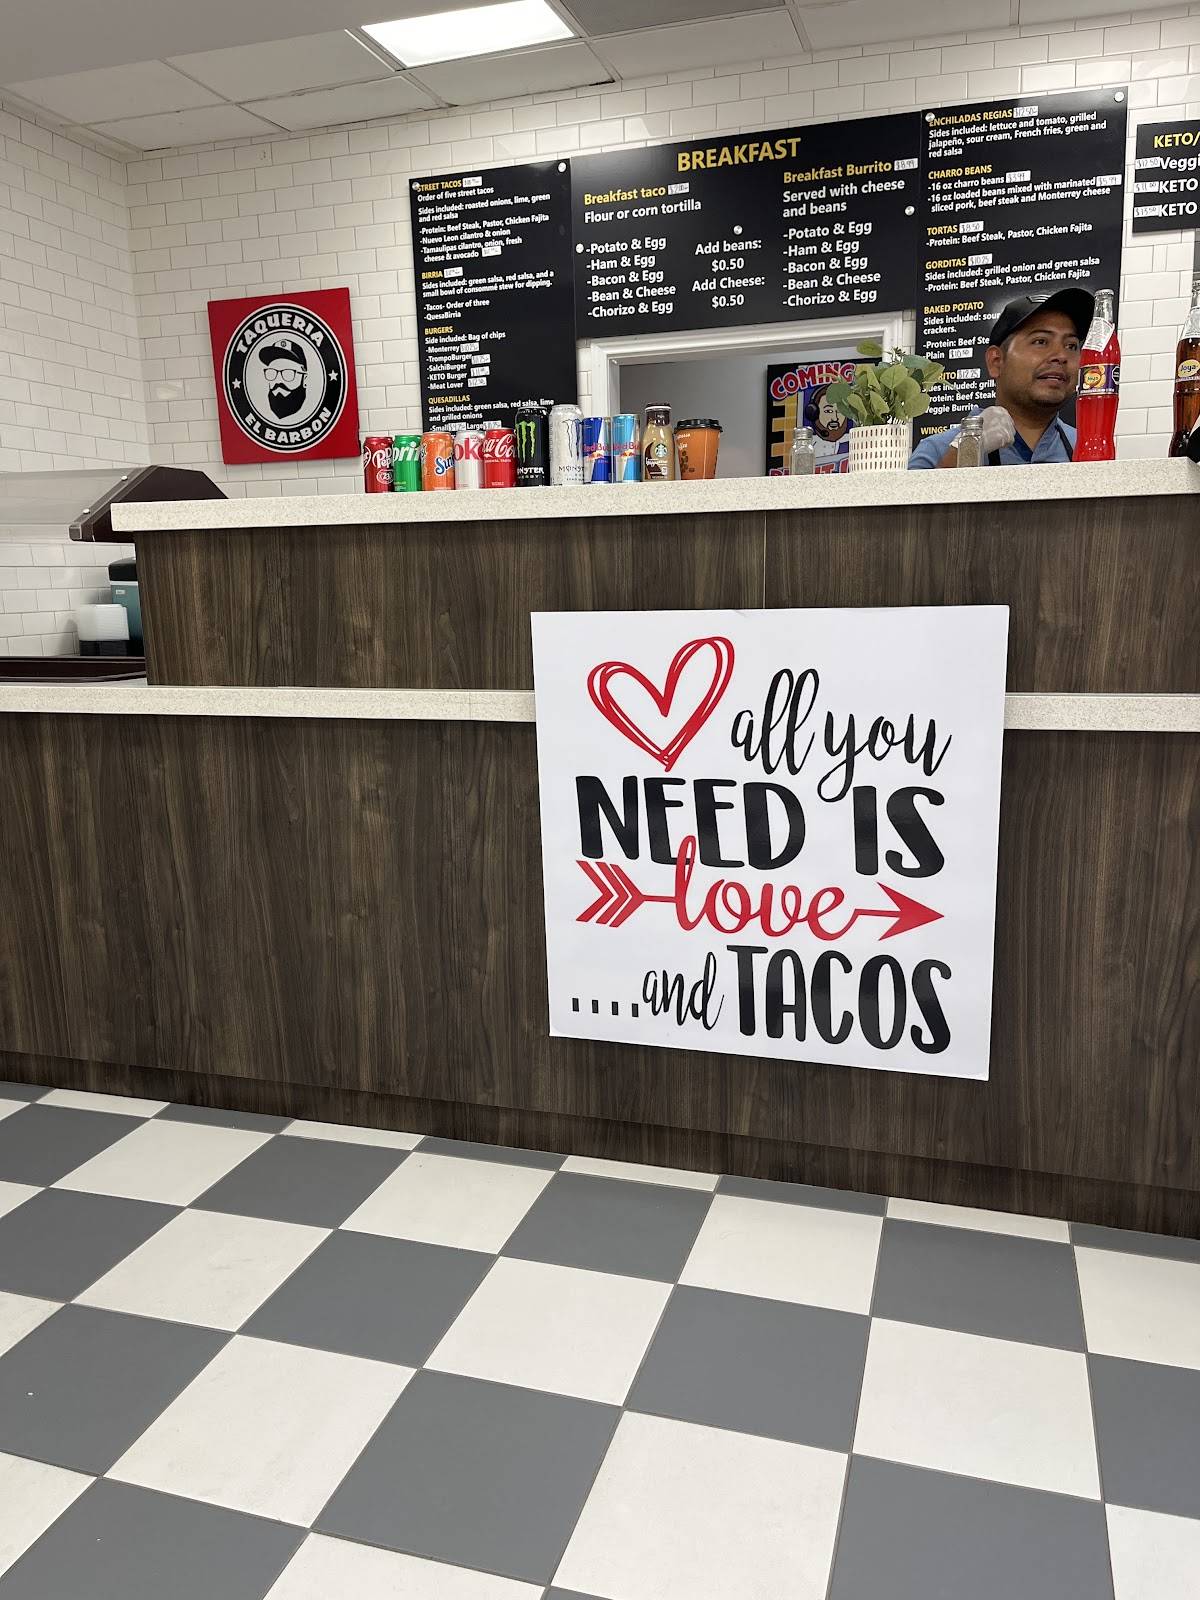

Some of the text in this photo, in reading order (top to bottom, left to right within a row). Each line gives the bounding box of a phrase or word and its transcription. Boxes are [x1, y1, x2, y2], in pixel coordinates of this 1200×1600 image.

[983, 109, 1012, 120] REGIAS
[929, 111, 1096, 138] Sides included: lettuce and tomato, grilled
[928, 120, 1106, 149] jalapeño, sour cream, French fries, green and
[677, 138, 801, 171] BREAKFAST
[929, 147, 963, 158] red salsa
[784, 161, 892, 183] Breakfast Burrito
[928, 164, 992, 179] CHARRO BEANS
[440, 180, 462, 189] TACOS
[953, 189, 980, 200] loaded
[982, 188, 1006, 197] beans
[1007, 183, 1032, 194] mixed
[1034, 181, 1052, 191] with
[1054, 177, 1096, 189] marinated
[954, 179, 979, 188] charro
[981, 176, 1004, 186] beans
[1159, 178, 1198, 193] KETO
[417, 194, 436, 202] Order
[436, 192, 444, 200] of
[457, 188, 476, 197] street
[584, 189, 638, 205] Breakfast
[640, 187, 666, 198] taco
[783, 180, 905, 203] Served with cheese
[931, 187, 1111, 212] sliced pork, beef steak and Monterrey cheese
[585, 199, 701, 223] Flour or corn tortilla
[783, 202, 847, 218] and beans
[1158, 202, 1198, 217] KETO
[783, 221, 872, 240] -Potato & Egg
[927, 224, 958, 235] TORTAS
[962, 233, 980, 244] Beef
[981, 231, 1005, 241] Steak,
[1008, 229, 1034, 238] Pastor,
[1036, 225, 1068, 236] Chicken
[1070, 222, 1092, 234] Fajita
[586, 237, 666, 254] -Potato & Egg
[695, 240, 761, 255] Add beans:
[783, 240, 859, 257] -Ham & Egg
[586, 254, 655, 270] -Ham & Egg
[712, 258, 744, 272] $0.50
[783, 256, 868, 273] -Bacon & Egg
[925, 256, 1100, 281] Sides included: grilled onion and green salsa
[926, 258, 966, 269] GORDITAS
[422, 271, 443, 279] BIRRIA
[587, 270, 664, 286] -Bacon & Egg
[783, 273, 881, 290] -Bean & Cheese
[692, 276, 765, 292] Add Cheese:
[587, 286, 676, 302] -Bean & Cheese
[712, 294, 744, 309] $0.50
[783, 289, 877, 306] -Chorizo & Egg
[588, 301, 673, 317] -Chorizo & Egg
[924, 301, 984, 314] BAKED POTATO
[924, 316, 944, 325] Sides
[946, 312, 981, 323] included:
[236, 313, 324, 353] TAQUERIA
[425, 326, 453, 335] BURGERS
[923, 325, 957, 335] crackers.
[958, 336, 976, 346] Beef
[428, 394, 470, 405] QUESADILLAS
[244, 407, 332, 443] EL BARBON
[731, 668, 952, 802] all you
[576, 776, 945, 878] NEED IS
[674, 835, 855, 941] love
[727, 944, 952, 1054] TACOS
